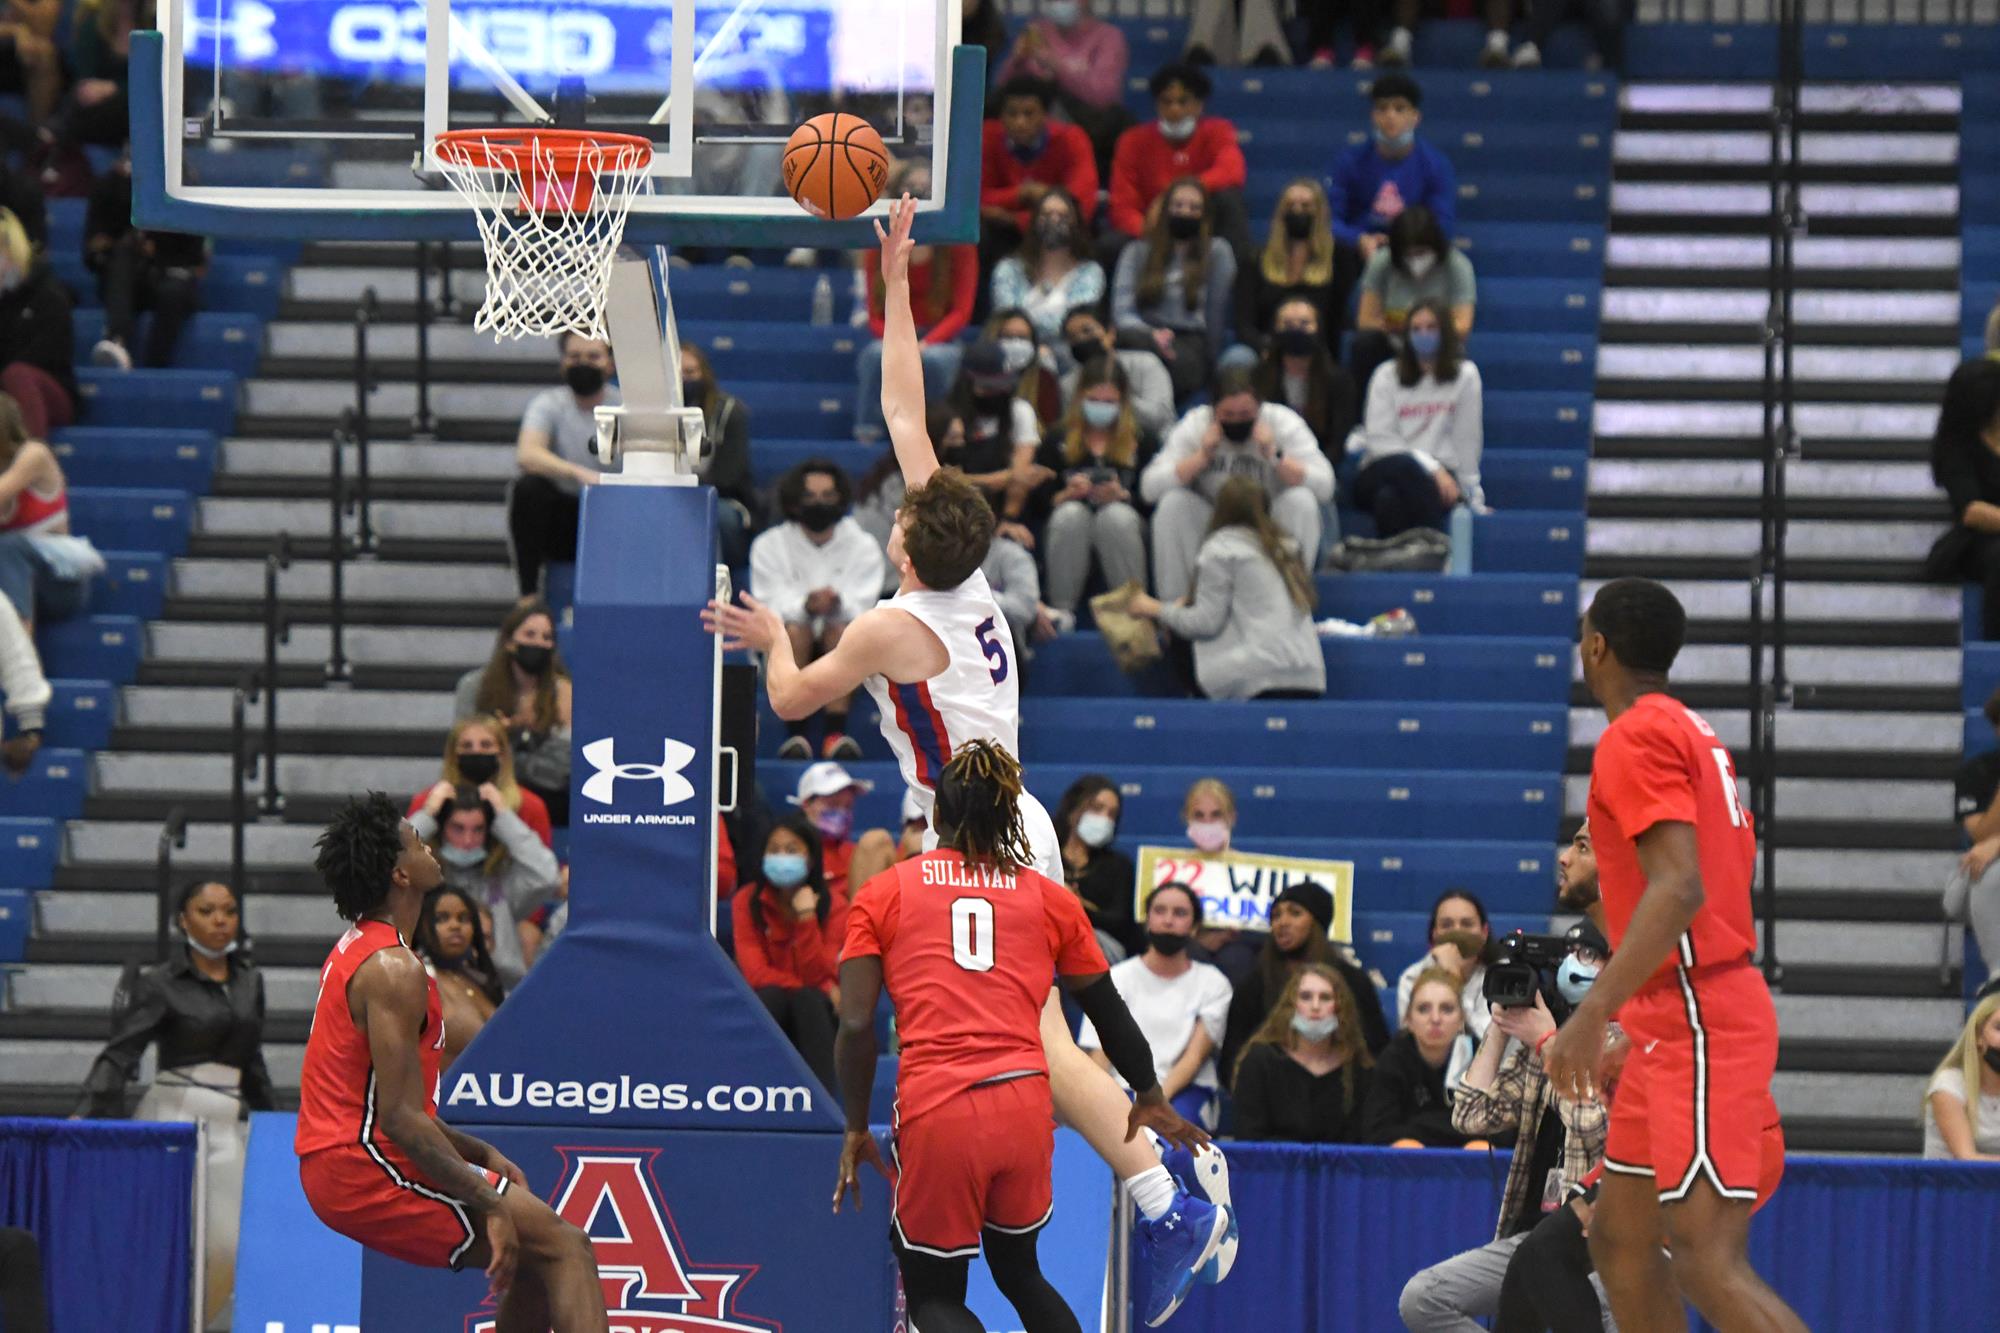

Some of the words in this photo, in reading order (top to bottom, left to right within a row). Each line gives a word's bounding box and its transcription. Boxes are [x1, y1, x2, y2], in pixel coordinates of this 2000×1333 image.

[975, 616, 1008, 687] 5
[583, 813, 631, 824] UNDER
[634, 814, 696, 825] ARMOUR
[921, 859, 1017, 890] SULLIVAN
[1157, 858, 1206, 897] 22
[1228, 864, 1311, 898] WI
[1200, 896, 1273, 922] DUN
[950, 896, 995, 972] 0
[446, 1072, 813, 1115] AUeagles.com
